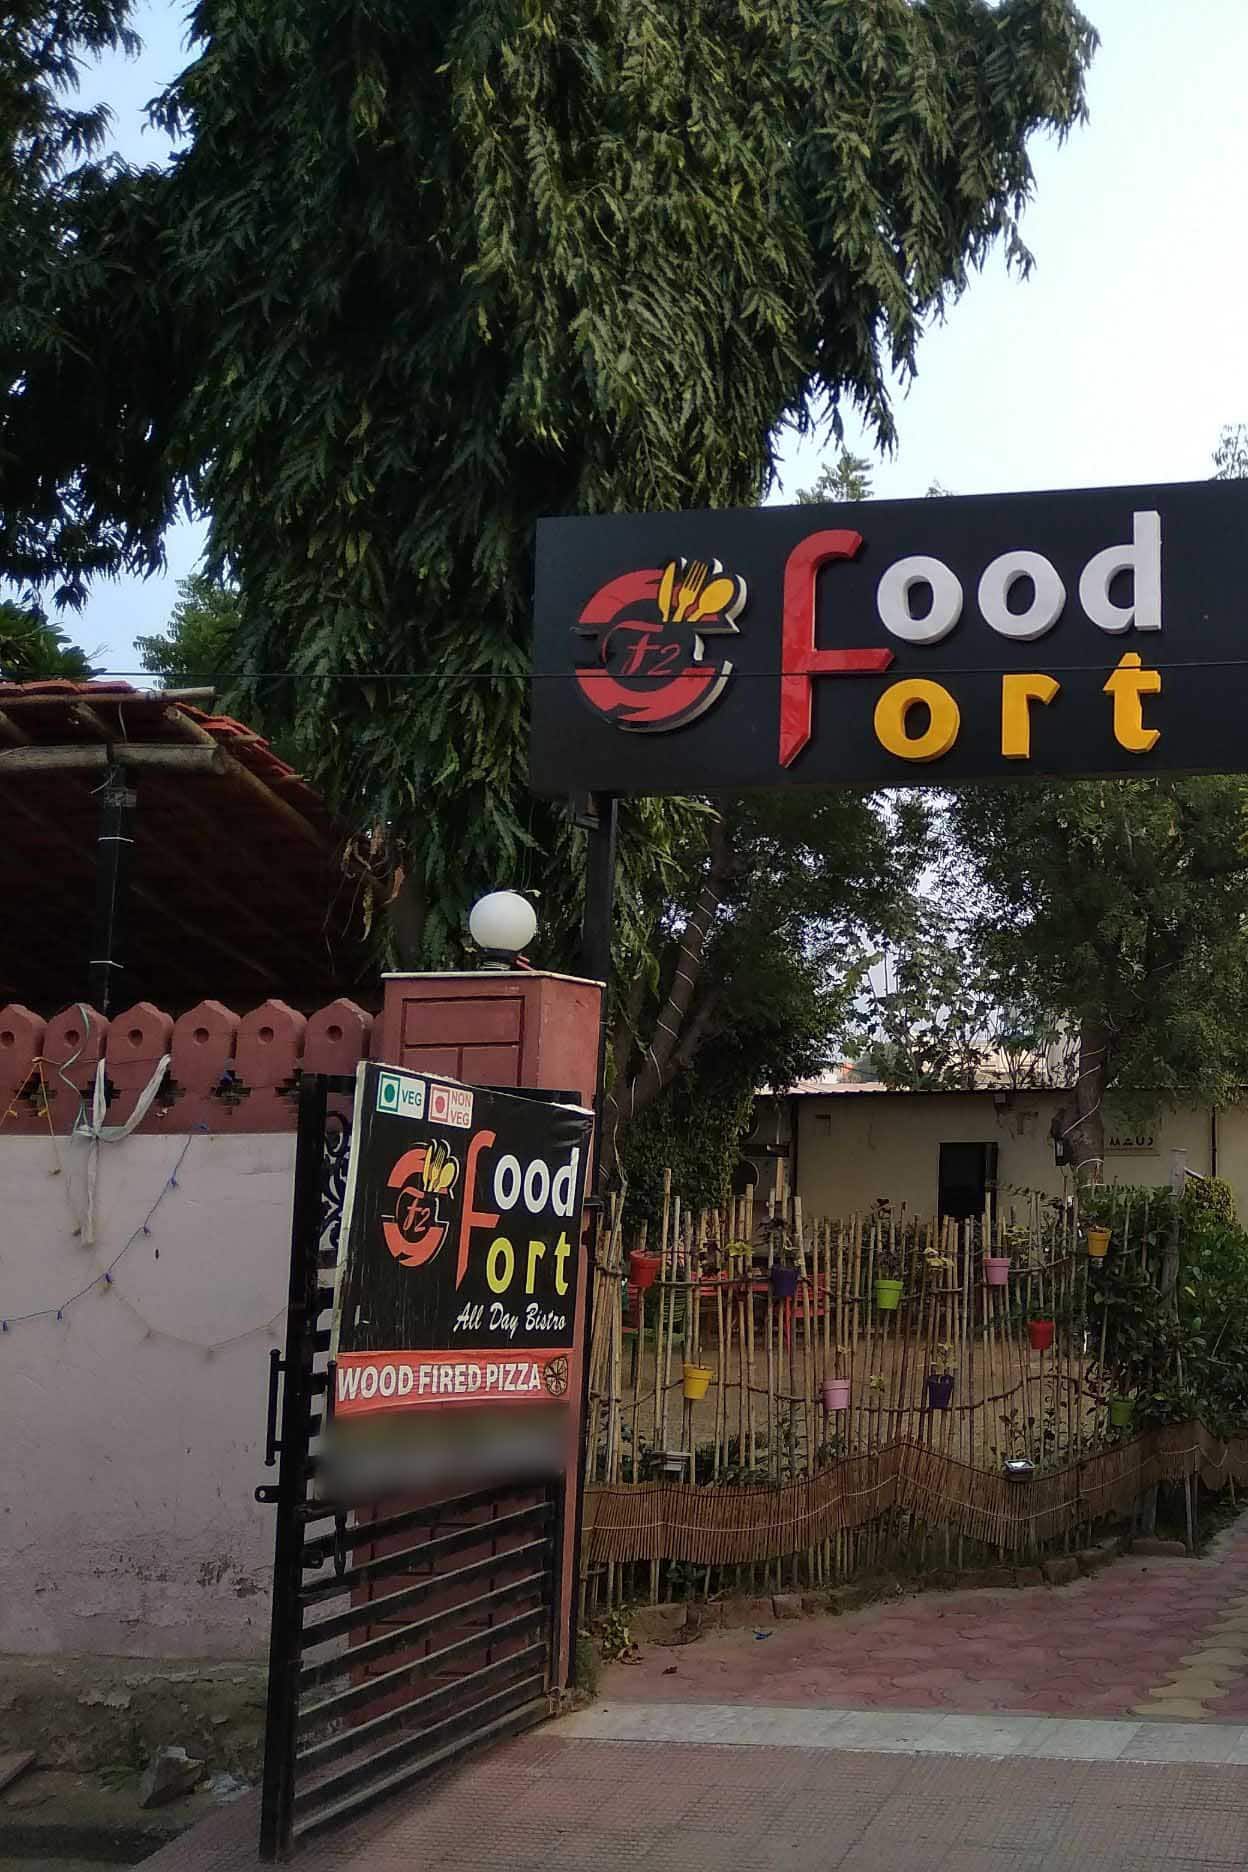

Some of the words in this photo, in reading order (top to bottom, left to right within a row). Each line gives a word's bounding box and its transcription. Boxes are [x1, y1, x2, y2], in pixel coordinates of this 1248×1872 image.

[401, 1088, 422, 1106] VEG
[451, 1090, 472, 1108] NON
[450, 1110, 470, 1126] VEG
[453, 1301, 485, 1333] All
[489, 1302, 520, 1340] Day
[525, 1302, 567, 1331] Bistro
[337, 1365, 414, 1402] WOOD
[417, 1364, 482, 1395] FIRED
[485, 1362, 542, 1392] PIZZA
